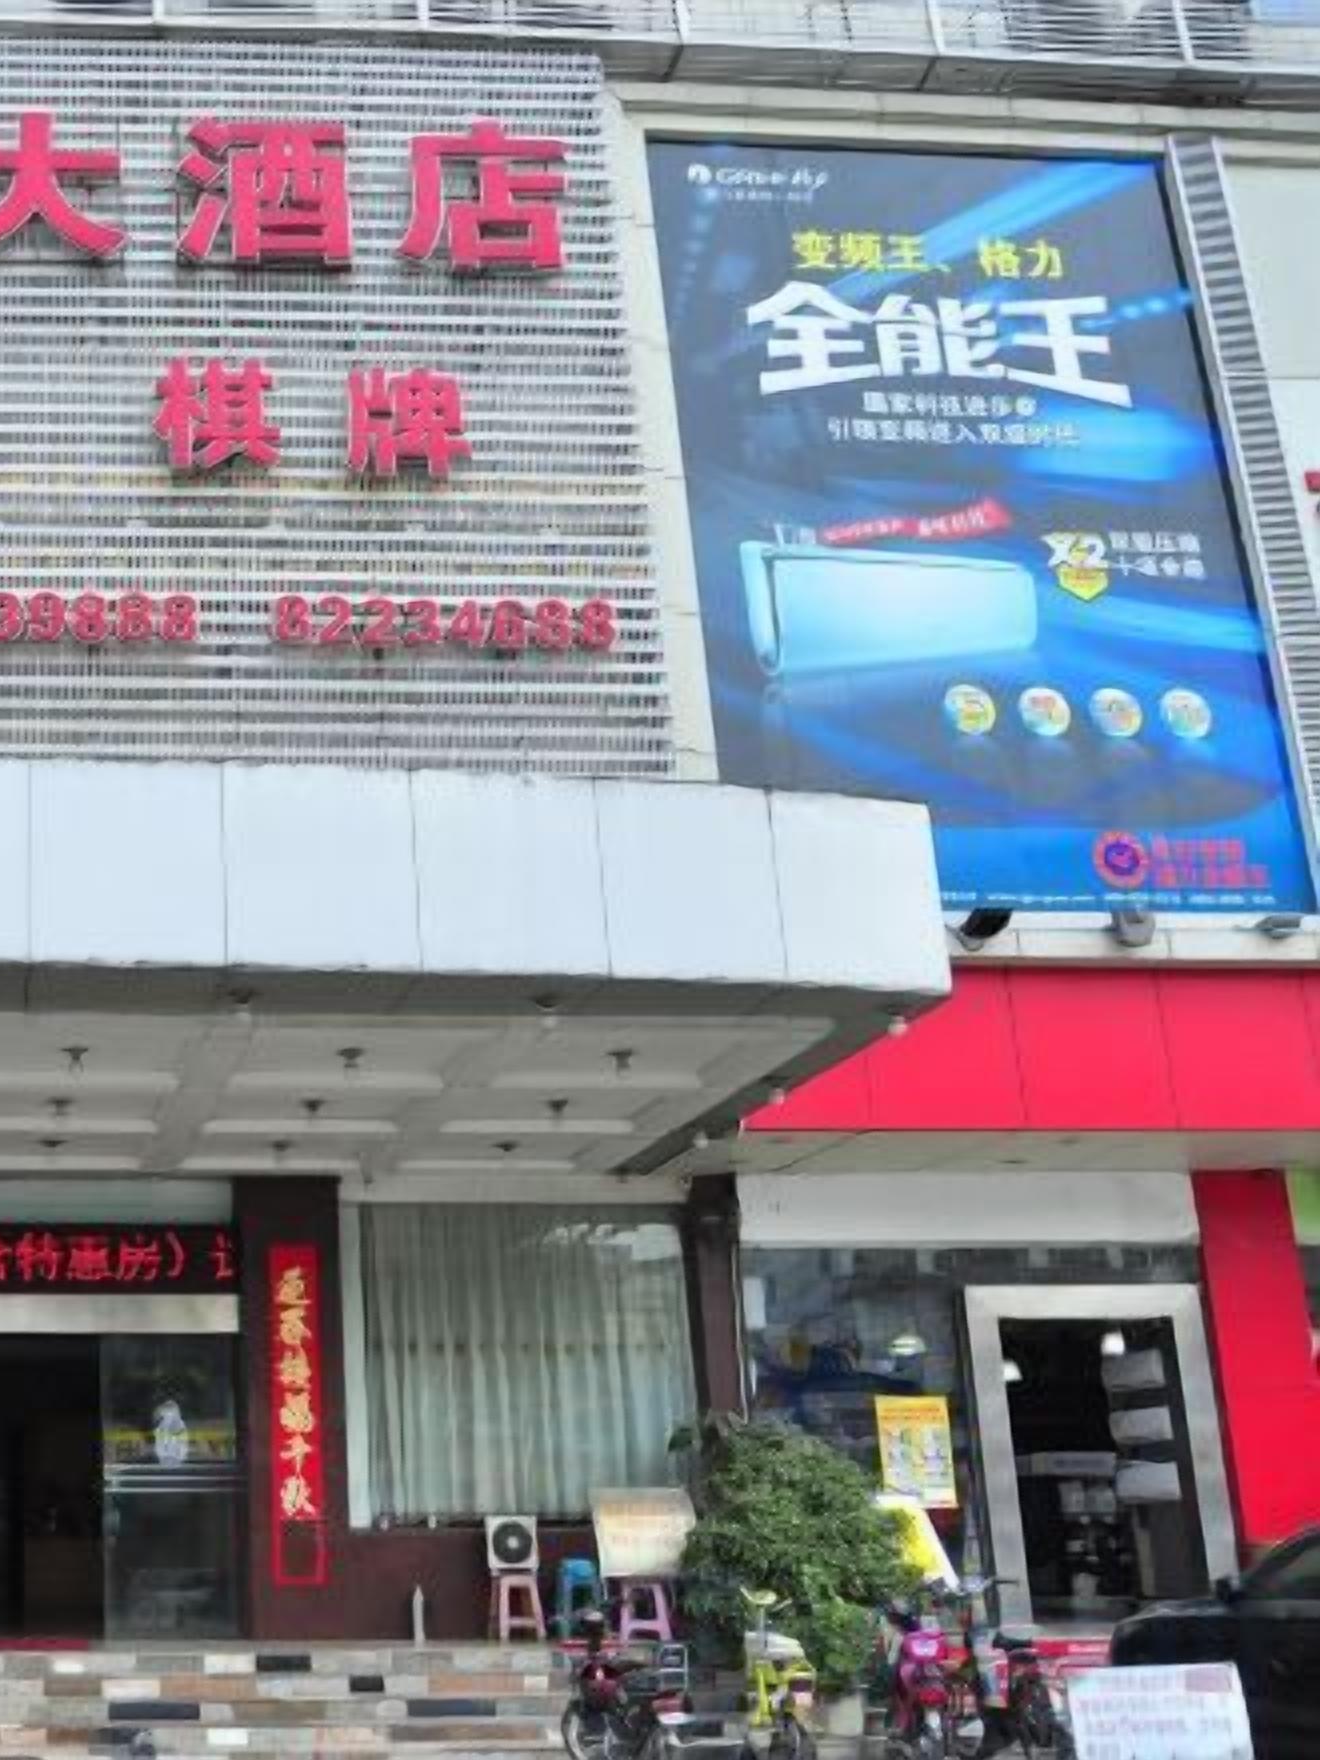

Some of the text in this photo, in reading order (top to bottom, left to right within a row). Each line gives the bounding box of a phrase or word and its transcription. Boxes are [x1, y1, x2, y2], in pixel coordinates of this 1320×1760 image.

[746, 281, 1133, 408] 全能王
[152, 358, 473, 476] 棋牌
